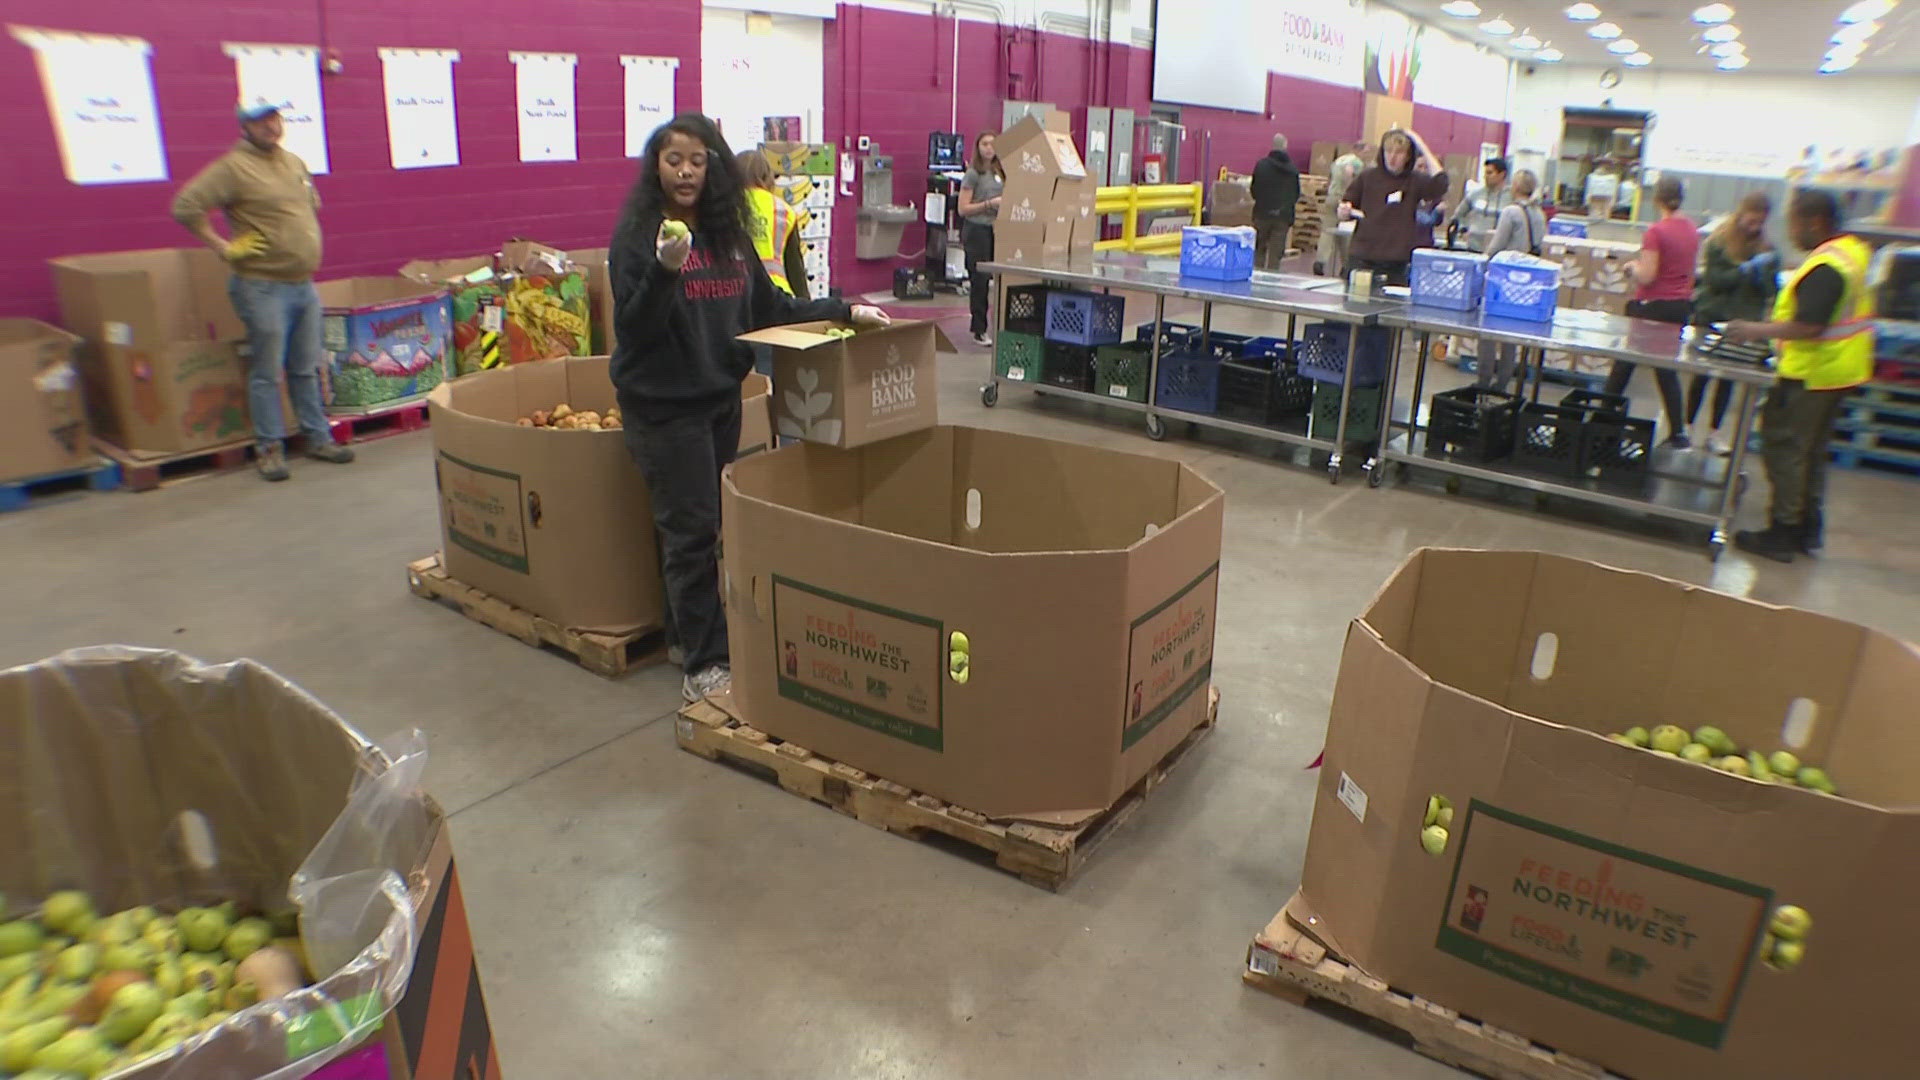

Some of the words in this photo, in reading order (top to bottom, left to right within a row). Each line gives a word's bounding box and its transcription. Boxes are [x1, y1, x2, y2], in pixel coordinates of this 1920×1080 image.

[1283, 11, 1311, 39] FOOD
[685, 278, 746, 299] UNIVERSITY
[872, 364, 915, 389] FOOD
[872, 382, 915, 409] BANK
[806, 610, 877, 648] FEEDING
[882, 642, 902, 657] THE
[806, 629, 910, 674] NORTHWEST
[1151, 612, 1206, 667] NORTHWEST
[1512, 878, 1697, 949] NORTHWEST
[1519, 858, 1645, 911] FEEDING
[1652, 907, 1689, 928] THE
